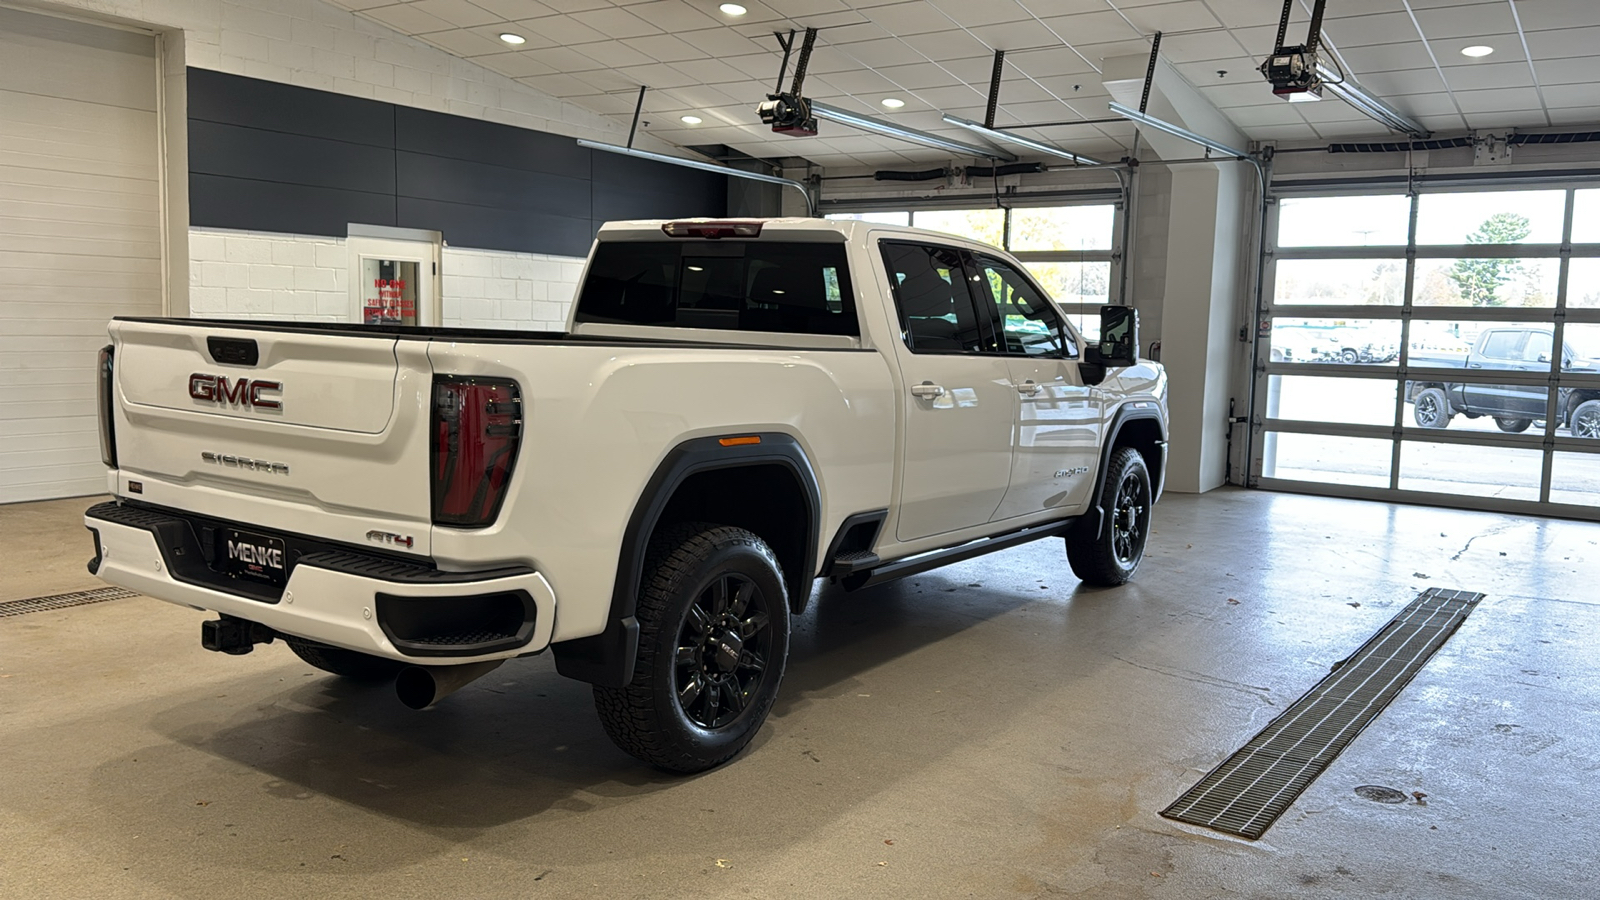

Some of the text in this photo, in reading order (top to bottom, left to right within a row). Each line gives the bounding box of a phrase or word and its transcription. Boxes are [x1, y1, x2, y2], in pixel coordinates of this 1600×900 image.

[374, 279, 405, 289] NO ONE
[367, 298, 413, 308] SAFETY GLASSES
[189, 373, 283, 412] GMC
[201, 451, 289, 474] SIERRA
[366, 529, 414, 549] AT4
[228, 540, 283, 569] MENKE
